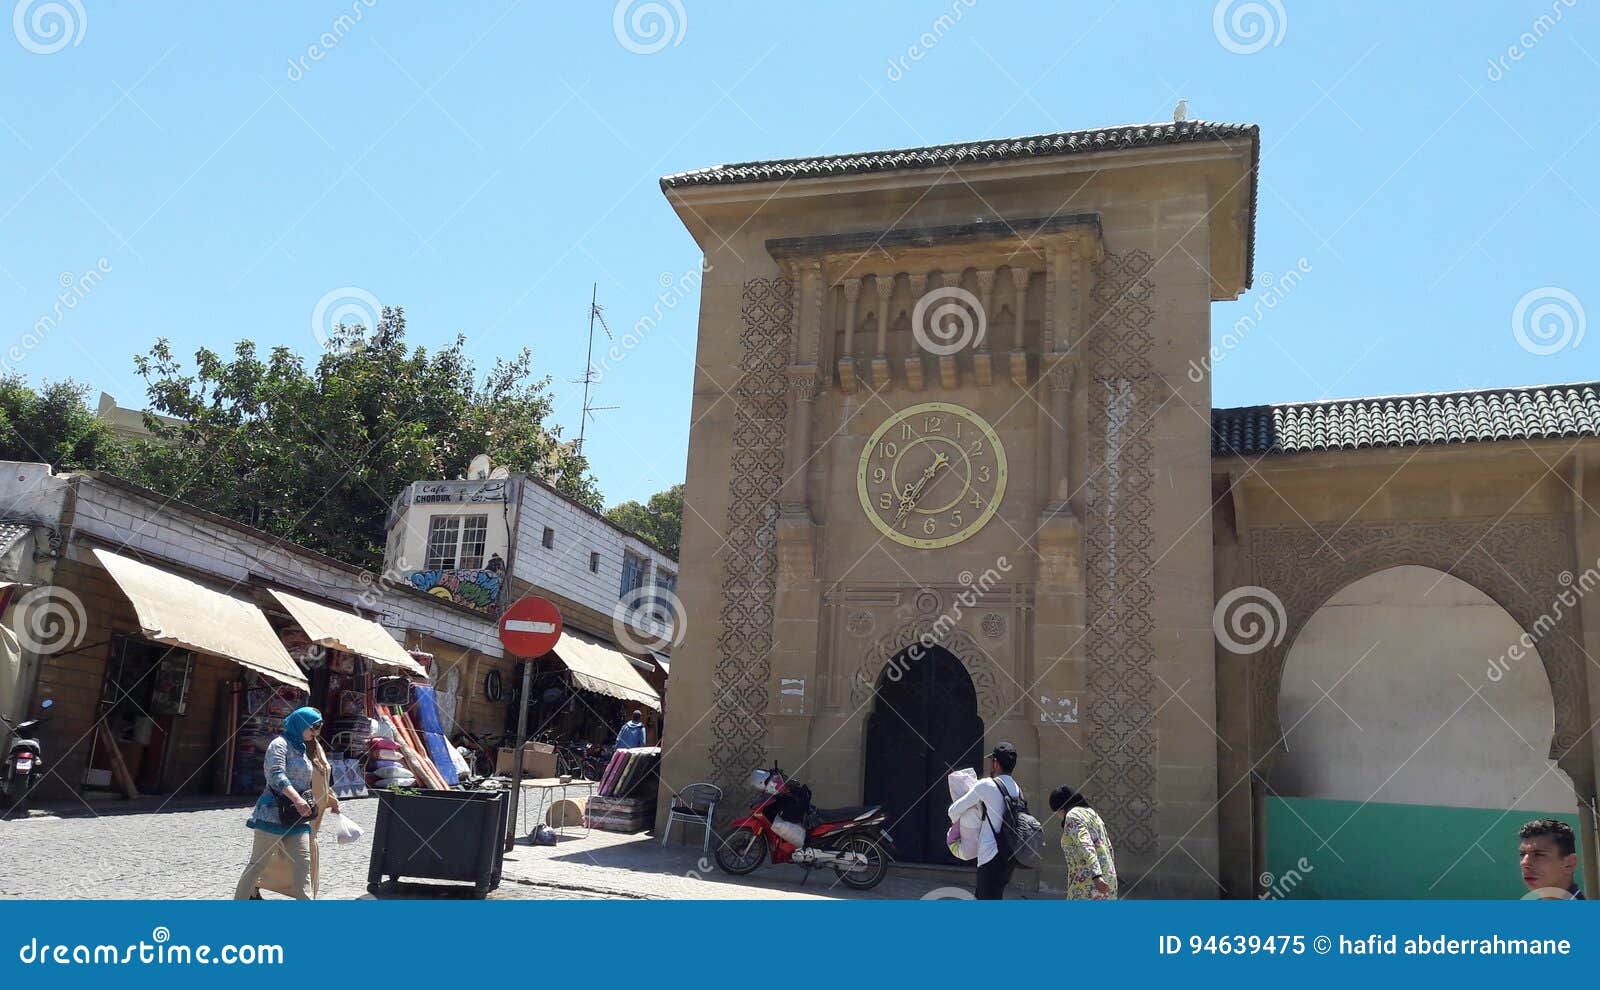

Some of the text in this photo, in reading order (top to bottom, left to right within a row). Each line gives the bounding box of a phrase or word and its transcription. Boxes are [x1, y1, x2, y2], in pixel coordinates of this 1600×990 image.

[902, 424, 913, 440] 11
[924, 416, 942, 433] 12
[879, 442, 898, 459] 10
[970, 440, 984, 457] 2
[873, 467, 886, 484] 9
[978, 465, 990, 483] 3
[880, 492, 892, 510] 8
[923, 517, 936, 535] 6
[951, 510, 962, 528] 5
